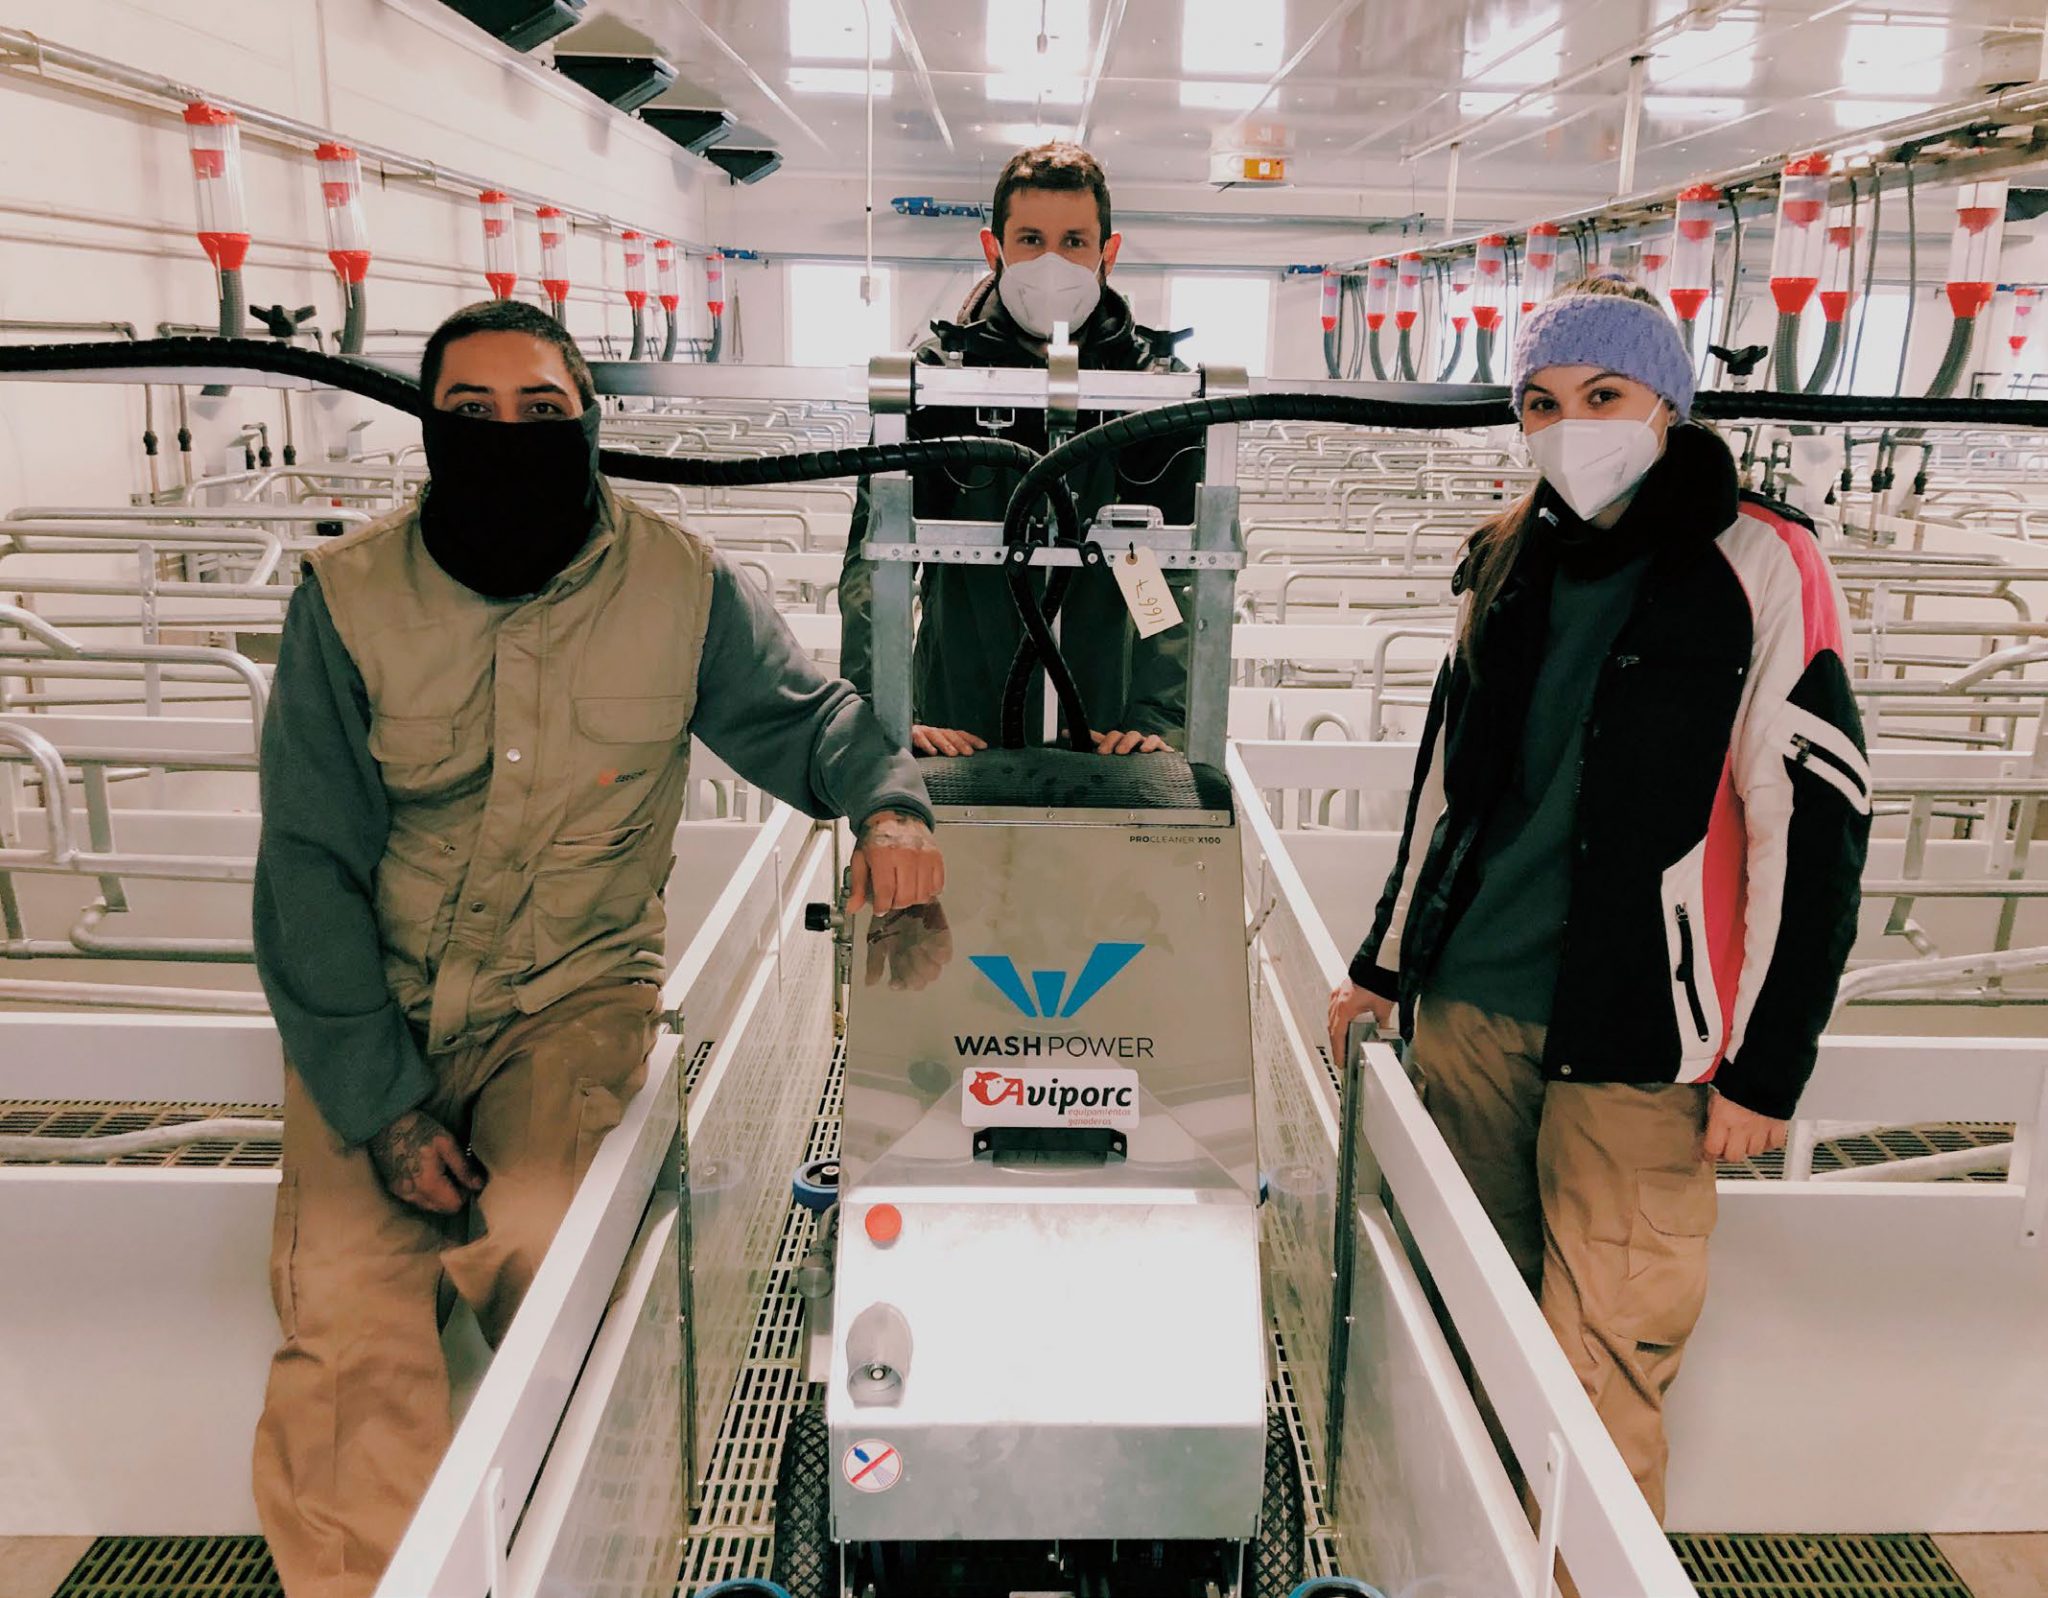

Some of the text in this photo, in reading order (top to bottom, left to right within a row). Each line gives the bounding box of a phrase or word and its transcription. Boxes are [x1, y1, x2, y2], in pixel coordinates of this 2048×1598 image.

[1129, 835, 1222, 845] PROCLEANER X100
[1000, 1077, 1133, 1115] Aviporc
